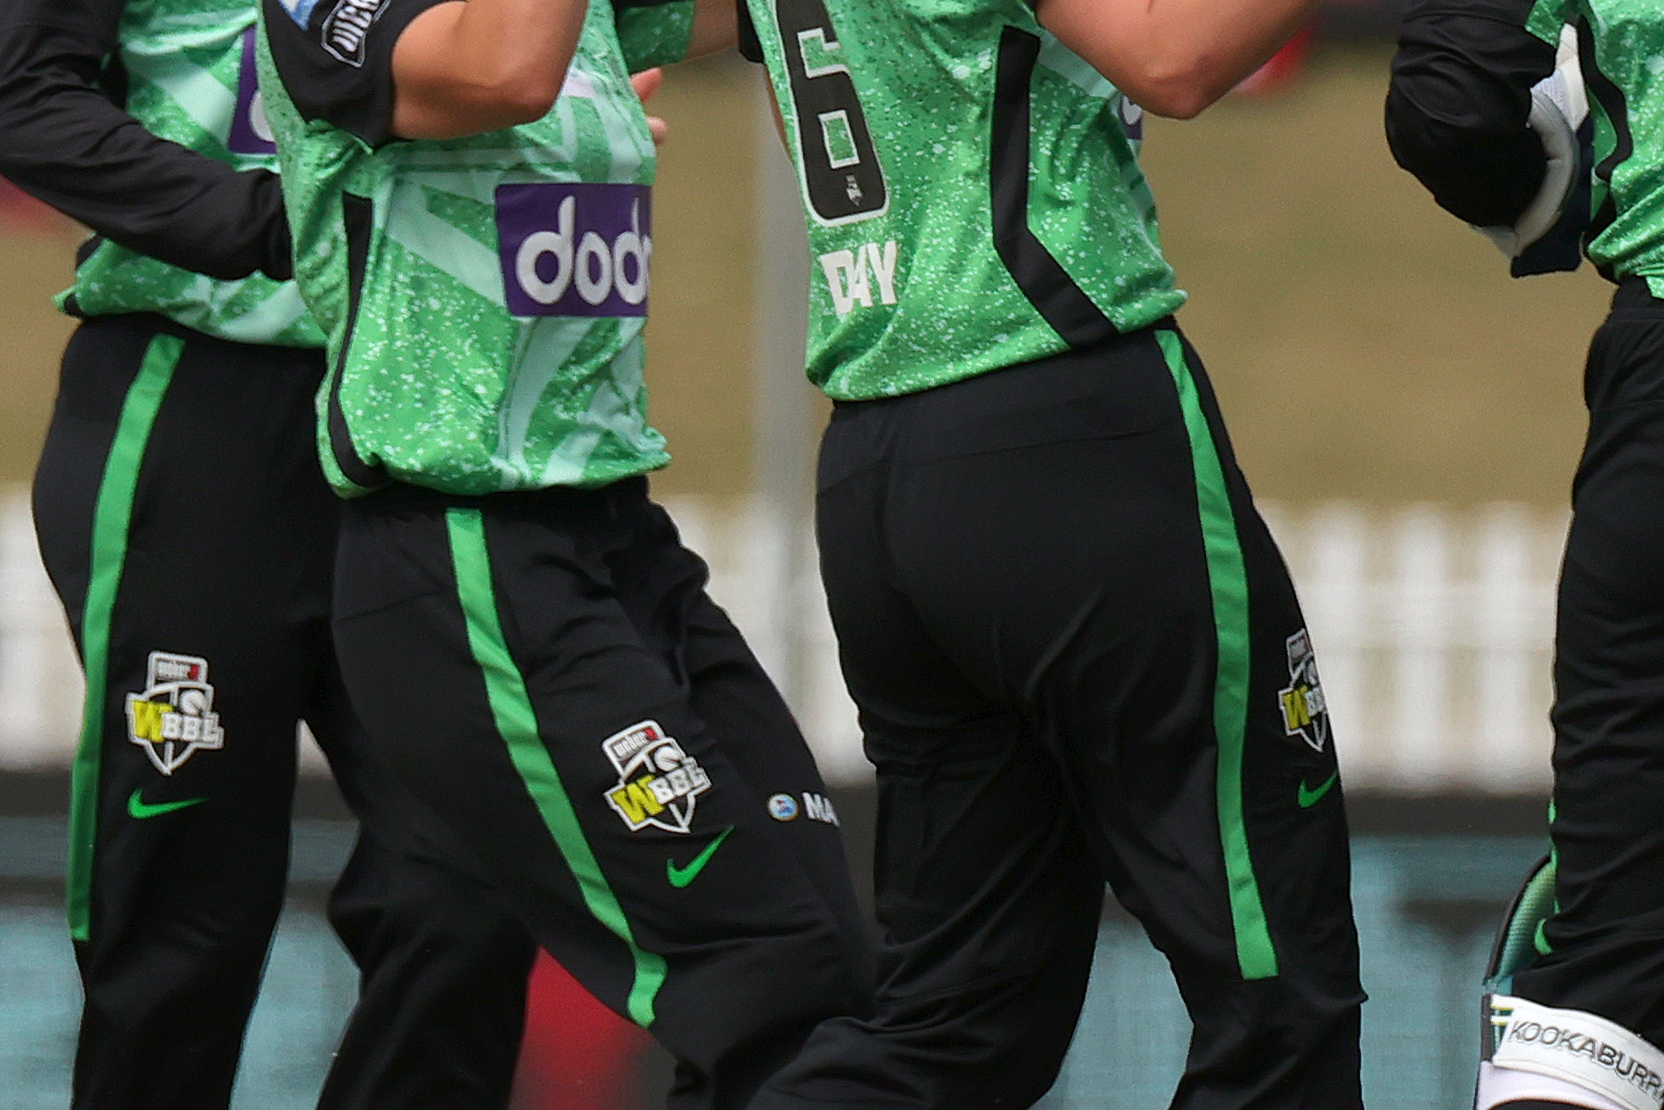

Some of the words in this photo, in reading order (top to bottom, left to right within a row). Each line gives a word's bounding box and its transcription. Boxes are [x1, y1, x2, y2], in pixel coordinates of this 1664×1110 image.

[819, 240, 898, 317] DAY
[133, 699, 219, 744] WBBL
[610, 758, 705, 825] WBBL
